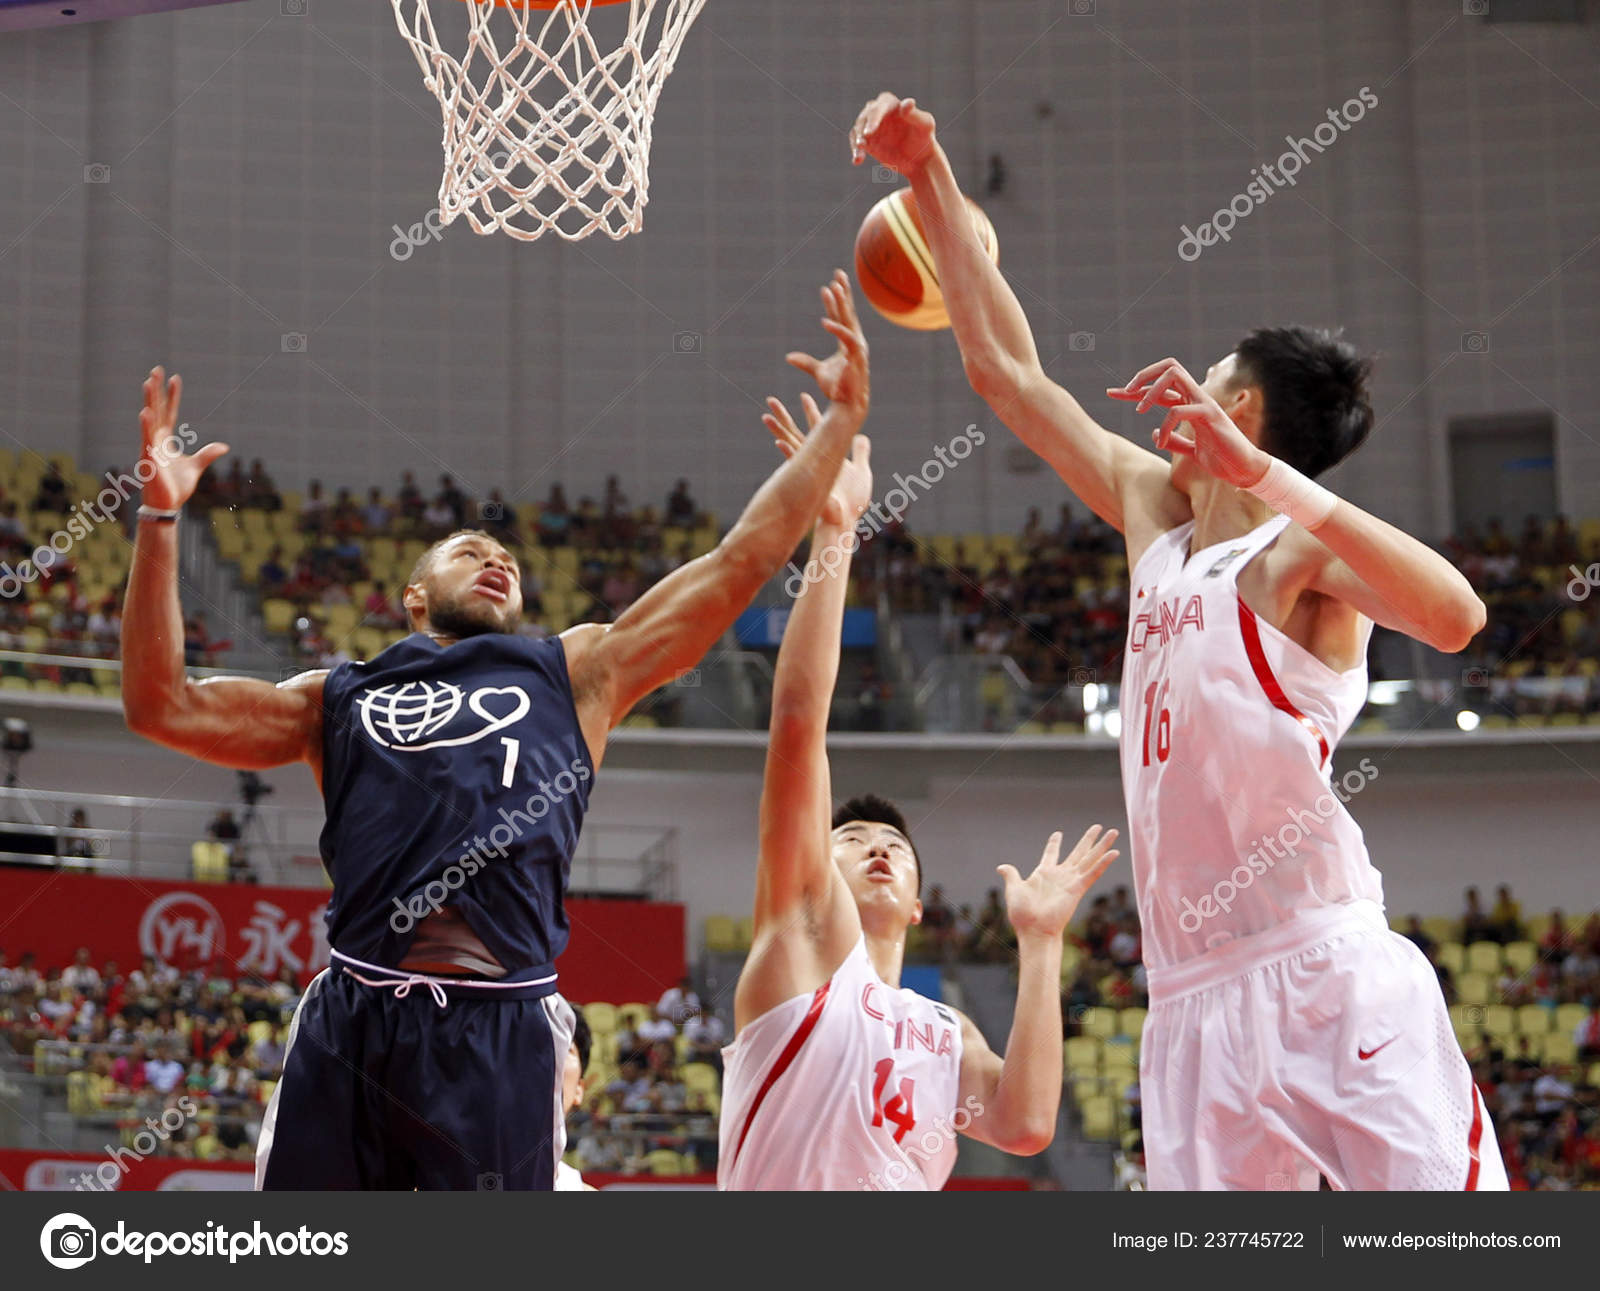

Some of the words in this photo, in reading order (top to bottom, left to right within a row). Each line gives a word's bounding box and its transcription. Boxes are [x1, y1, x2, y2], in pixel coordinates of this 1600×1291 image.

[1131, 595, 1204, 652] CHINA
[1143, 678, 1170, 767] 16
[501, 737, 520, 788] 1
[862, 982, 953, 1056] CINA
[871, 1057, 916, 1145] 14
